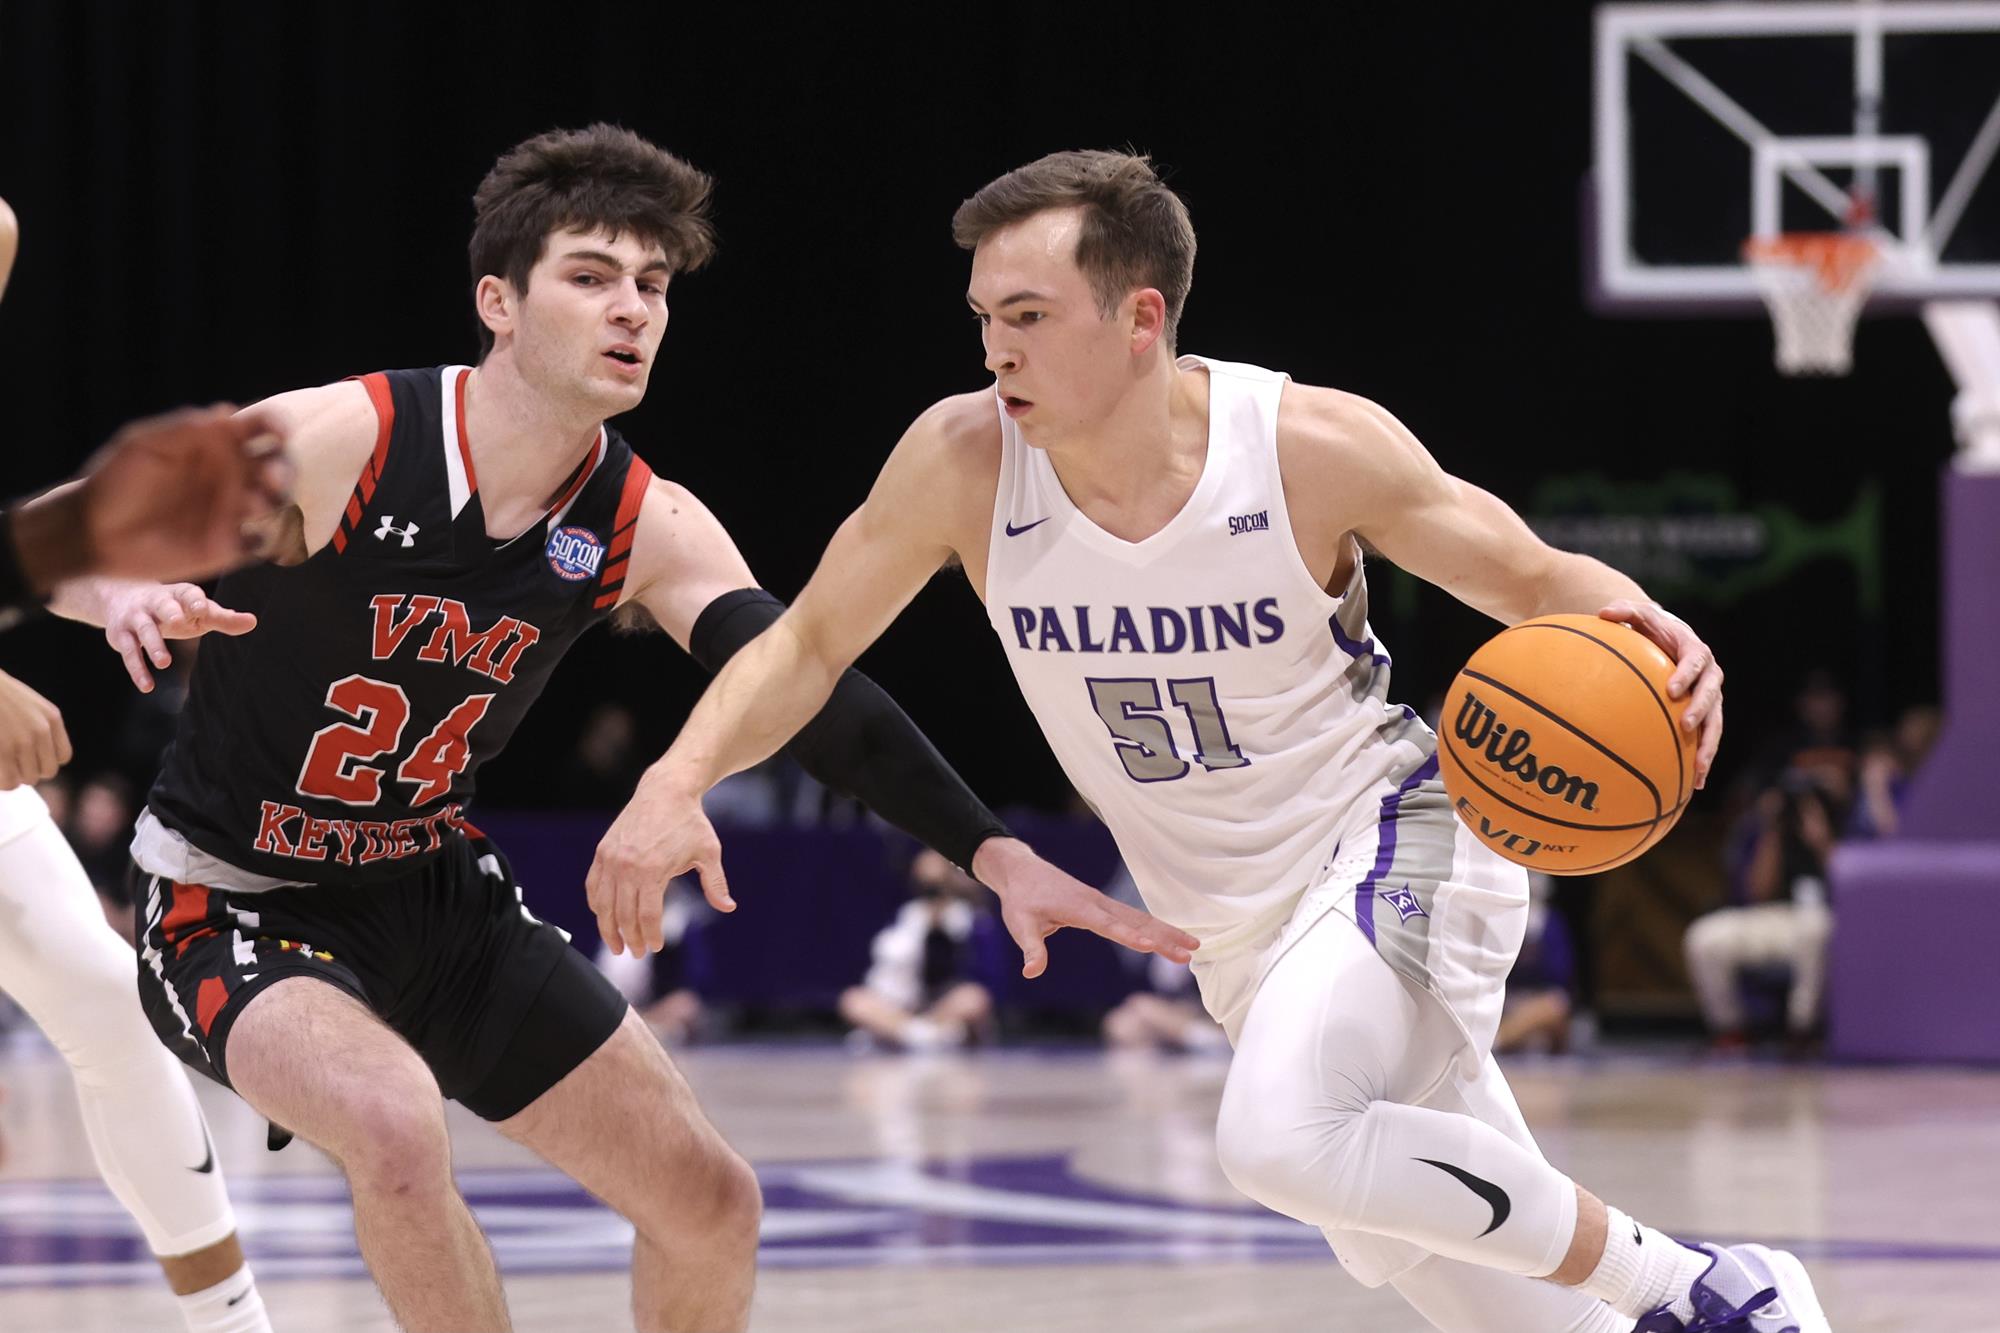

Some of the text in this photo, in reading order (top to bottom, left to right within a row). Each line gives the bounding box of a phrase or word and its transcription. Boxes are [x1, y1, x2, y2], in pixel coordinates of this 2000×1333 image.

[369, 594, 540, 684] VMI
[1009, 597, 1285, 654] PALADINS
[295, 674, 496, 807] 24
[1084, 676, 1251, 783] 51
[1455, 692, 1599, 811] Wilson
[1455, 796, 1580, 855] EVO NXT
